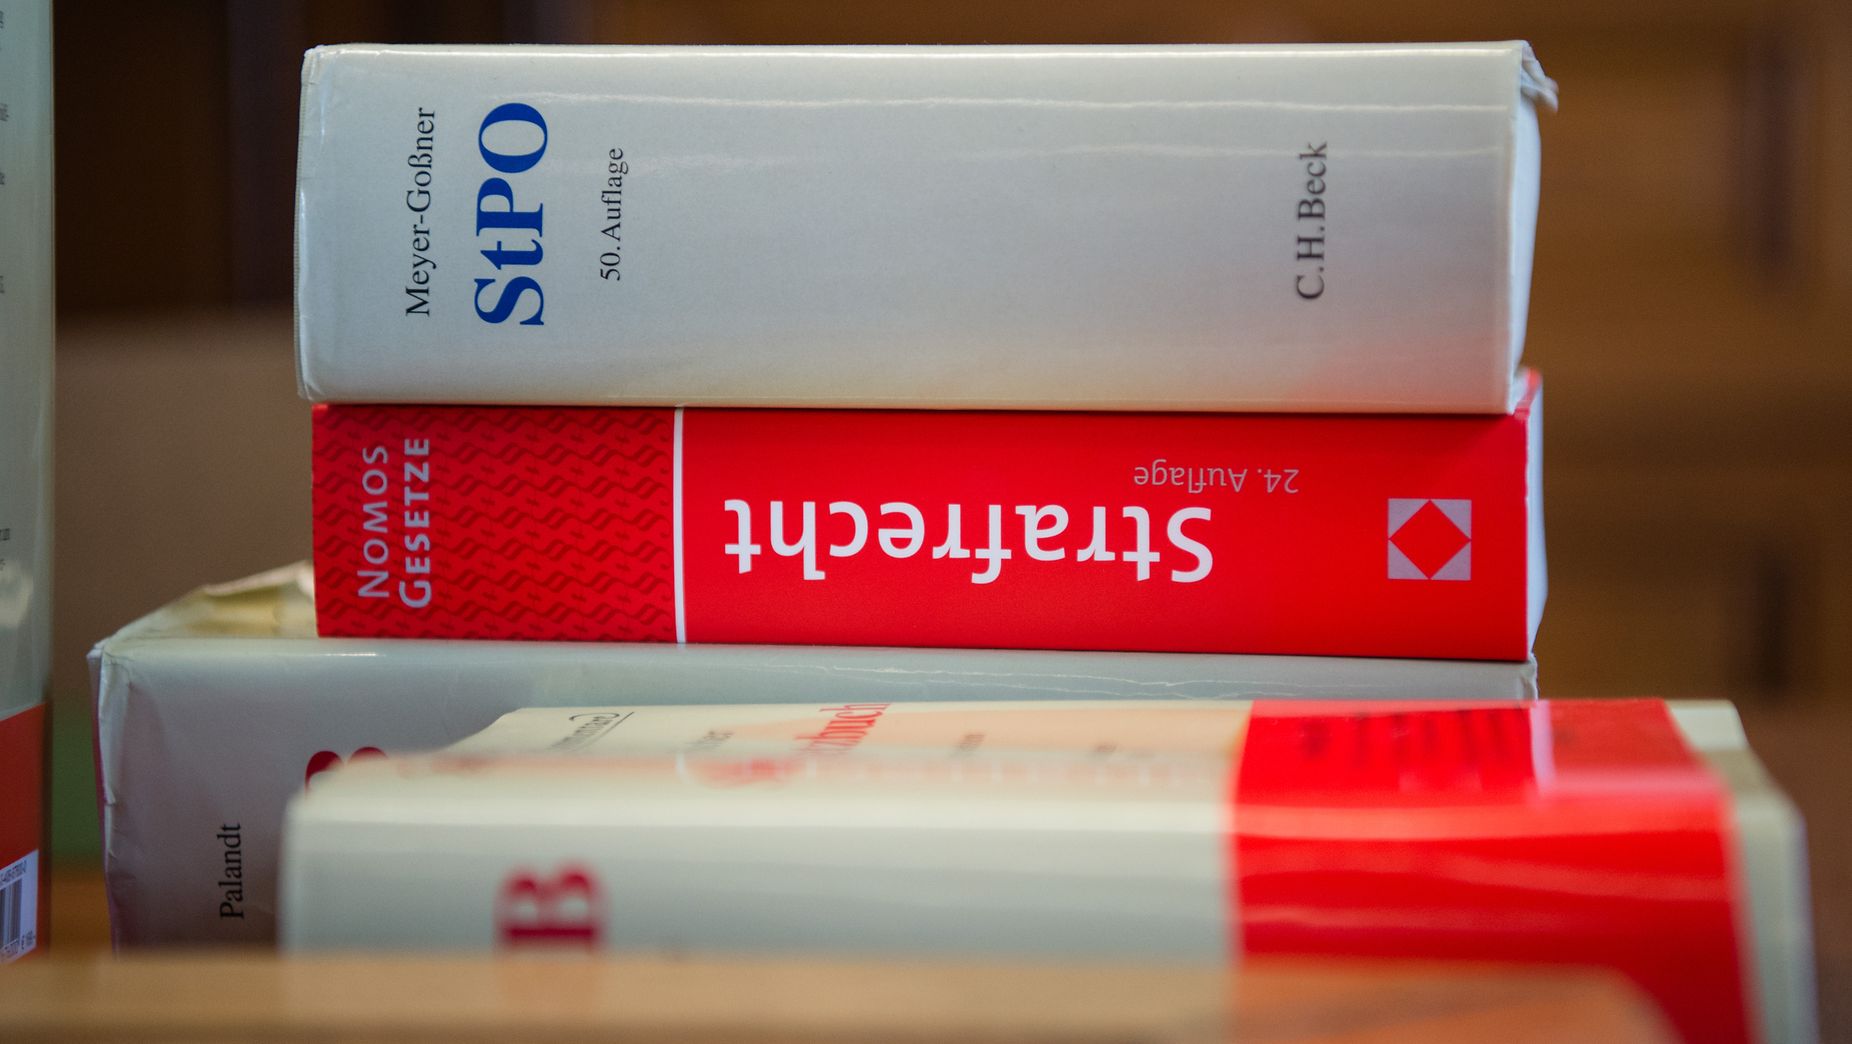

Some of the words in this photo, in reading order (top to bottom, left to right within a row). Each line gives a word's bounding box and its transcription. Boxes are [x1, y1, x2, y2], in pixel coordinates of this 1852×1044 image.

[405, 107, 437, 317] Meyer-Goßner
[474, 102, 548, 326] StPO
[357, 445, 390, 598] NOMOS
[399, 438, 432, 608] GESETZE
[1133, 458, 1249, 494] Auflage
[1257, 468, 1300, 494] 24.
[724, 499, 1214, 584] Strafrecht
[217, 823, 244, 919] Palandt
